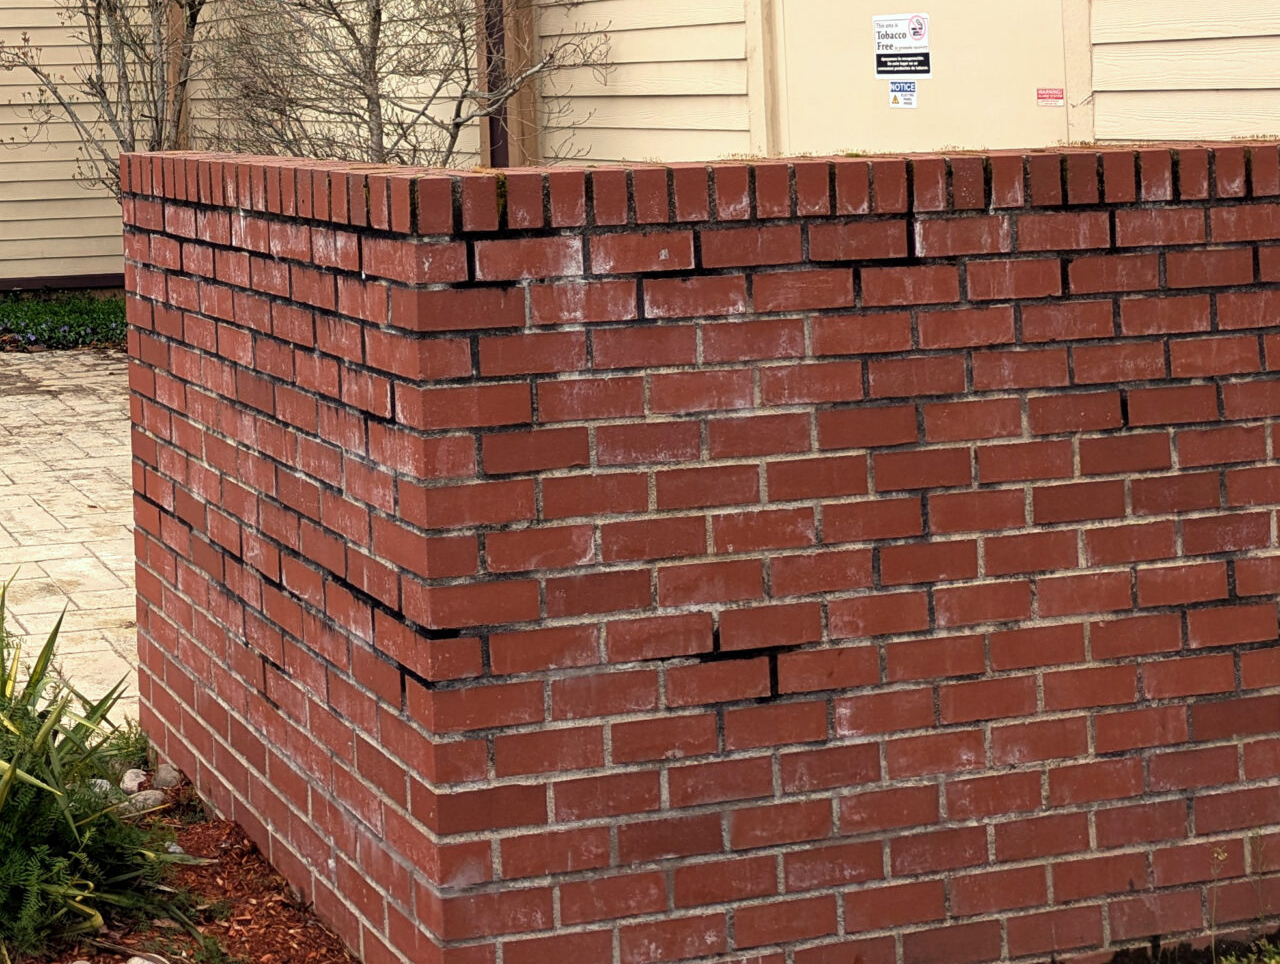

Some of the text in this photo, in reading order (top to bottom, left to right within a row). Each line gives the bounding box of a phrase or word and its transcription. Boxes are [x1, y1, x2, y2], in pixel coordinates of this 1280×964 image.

[876, 30, 907, 40] Tobacco
[877, 42, 894, 50] Free
[890, 84, 916, 92] NOTICE
